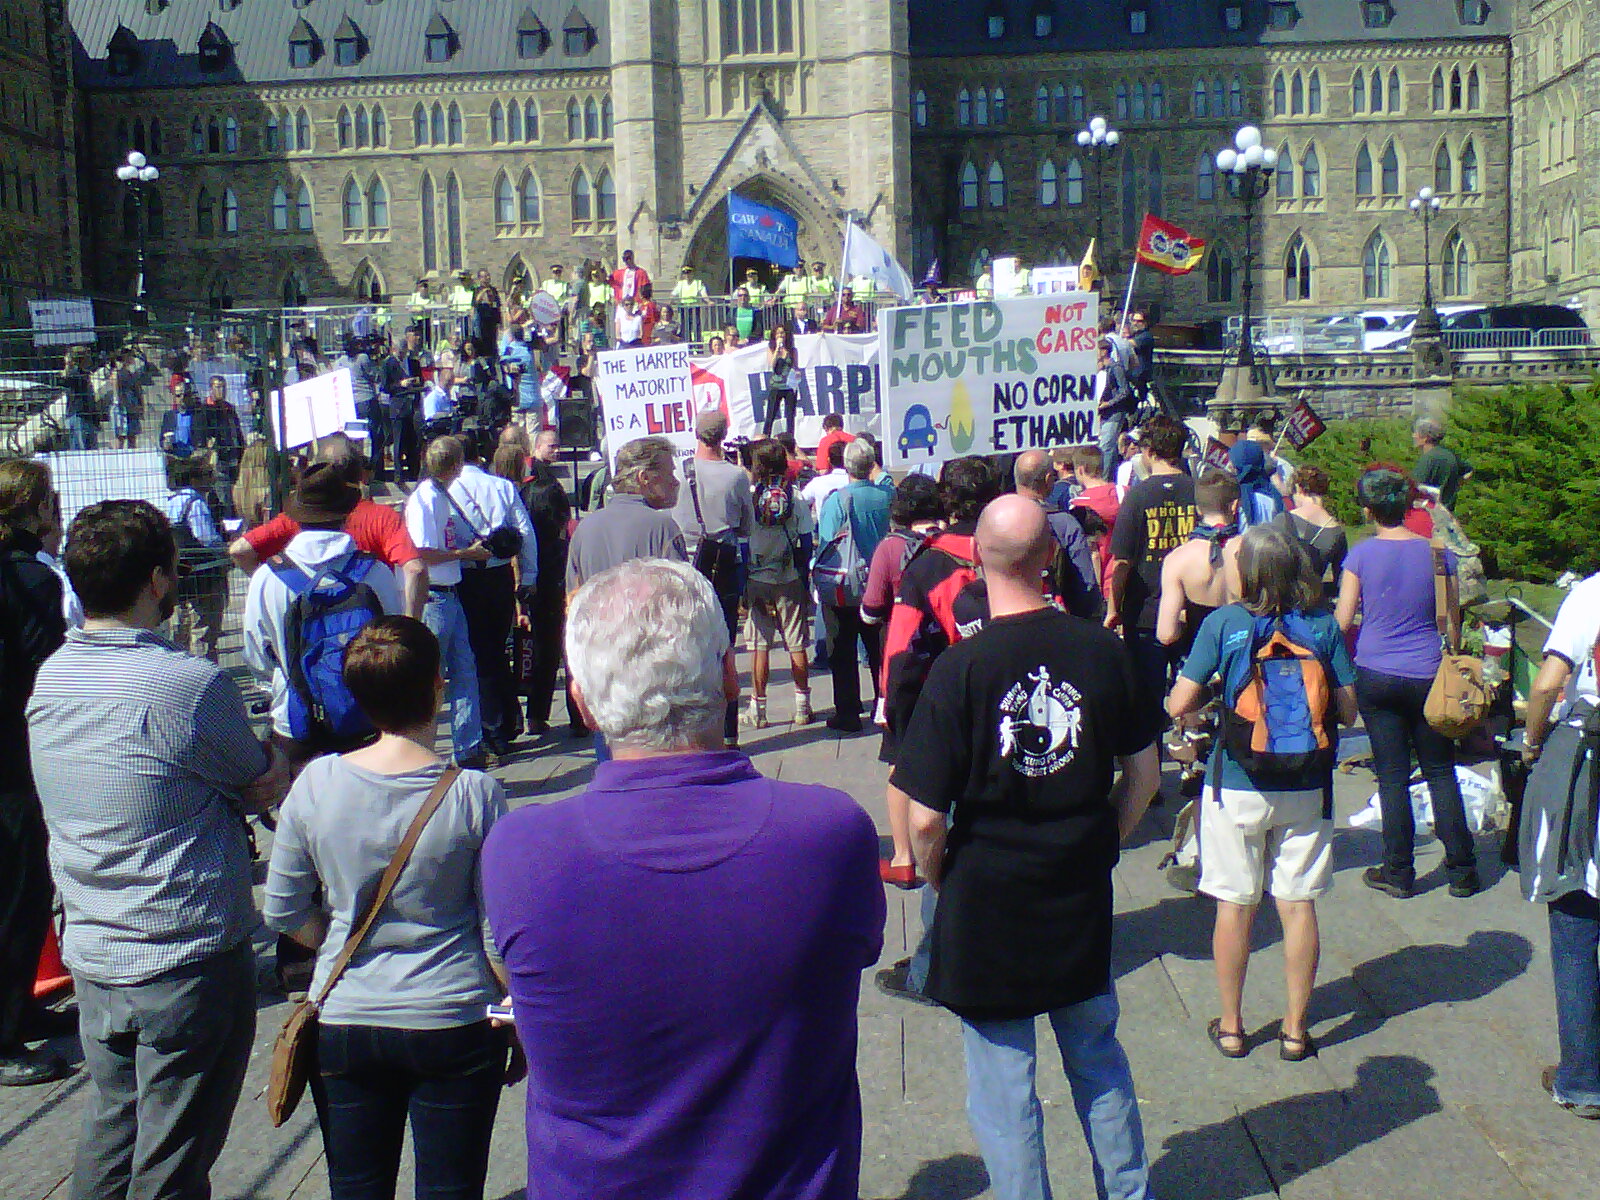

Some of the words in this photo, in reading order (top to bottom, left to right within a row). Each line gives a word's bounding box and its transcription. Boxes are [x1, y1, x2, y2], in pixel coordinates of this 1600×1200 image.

[731, 213, 759, 225] CAW
[893, 301, 1003, 350] FEED
[1045, 301, 1088, 324] NOT
[1036, 326, 1097, 354] CARS
[603, 359, 628, 375] THE
[635, 351, 689, 373] HARPER
[890, 337, 1039, 387] MOUTHS
[616, 375, 688, 401] MAJORITY
[748, 363, 881, 423] HARP
[993, 380, 1028, 413] NO
[1034, 374, 1096, 407] CORN
[610, 415, 625, 432] IS
[629, 413, 642, 430] A
[645, 399, 694, 436] LIE!
[993, 410, 1099, 451] ETHANOL
[1145, 505, 1195, 519] WHOLE
[1147, 516, 1195, 538] DAM
